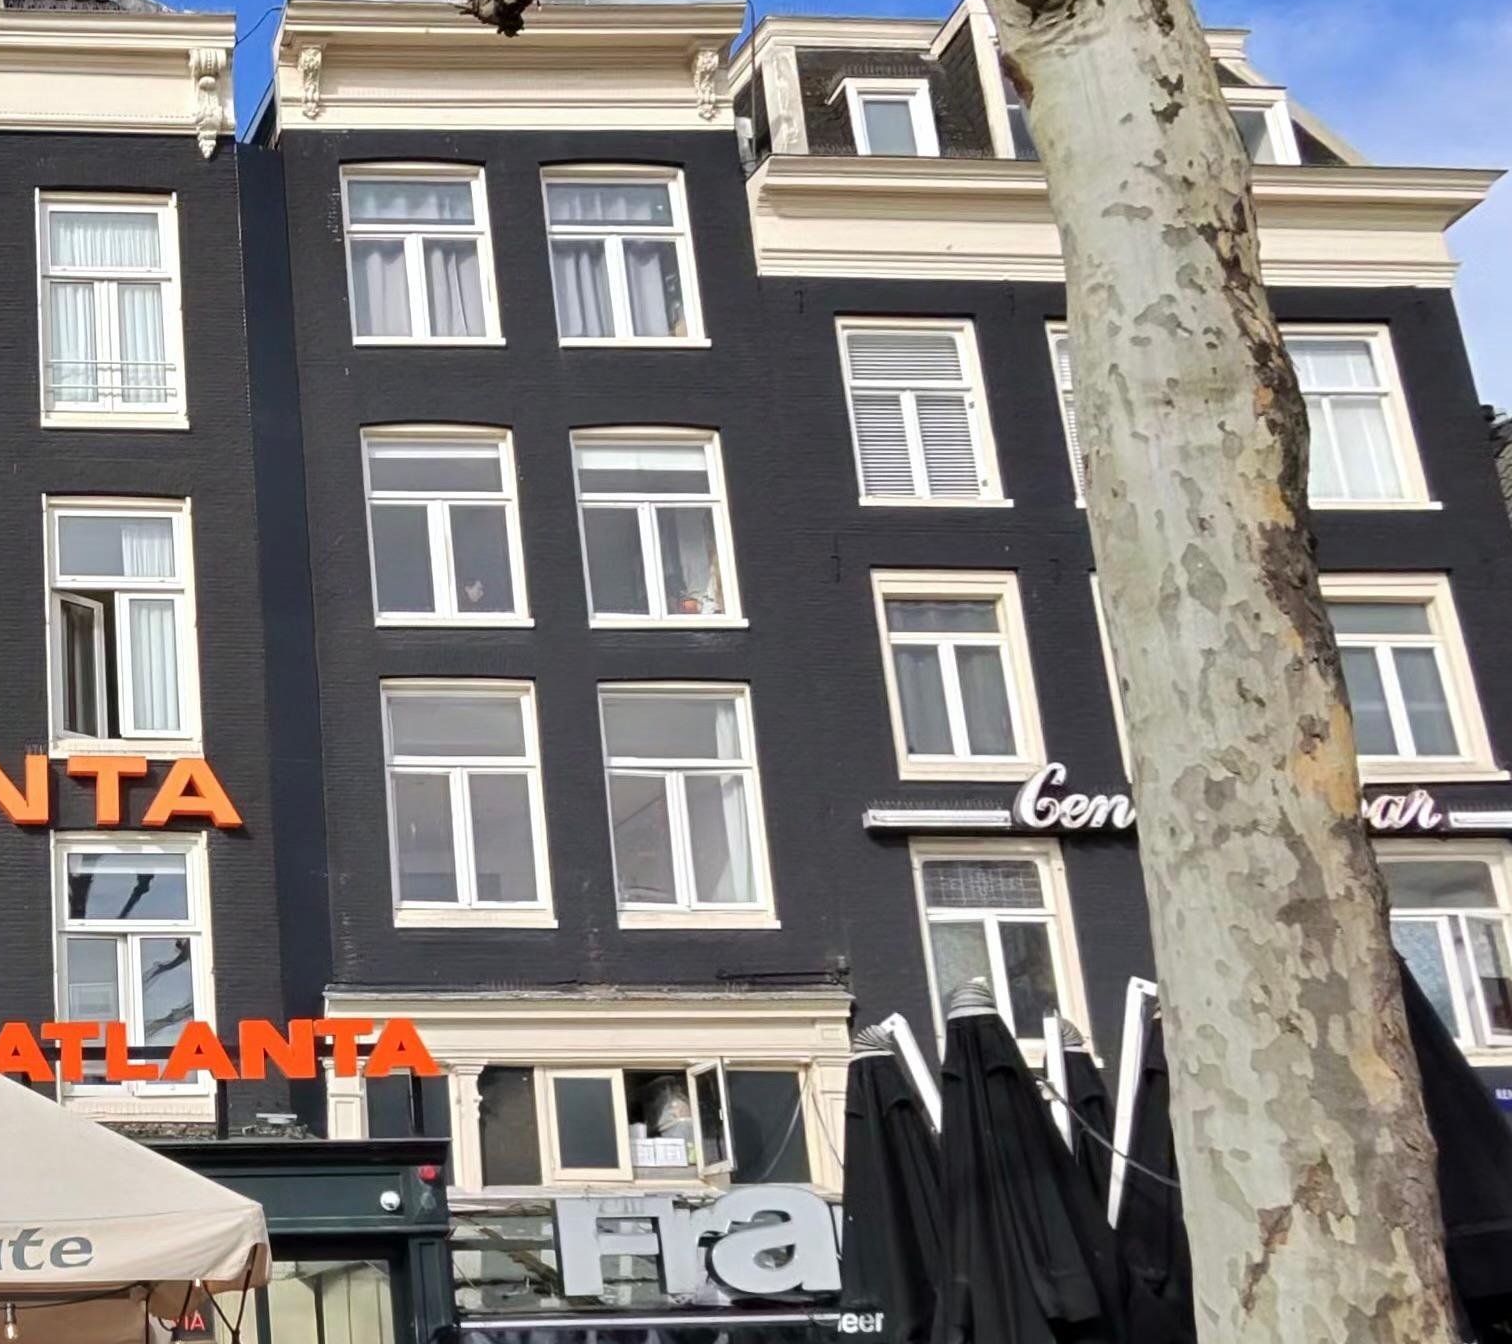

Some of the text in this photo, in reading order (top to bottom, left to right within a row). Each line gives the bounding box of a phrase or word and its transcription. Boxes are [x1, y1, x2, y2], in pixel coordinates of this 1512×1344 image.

[1014, 762, 1442, 828] Cen ar
[557, 1184, 843, 1297] Fra
[838, 1312, 885, 1333] eer
